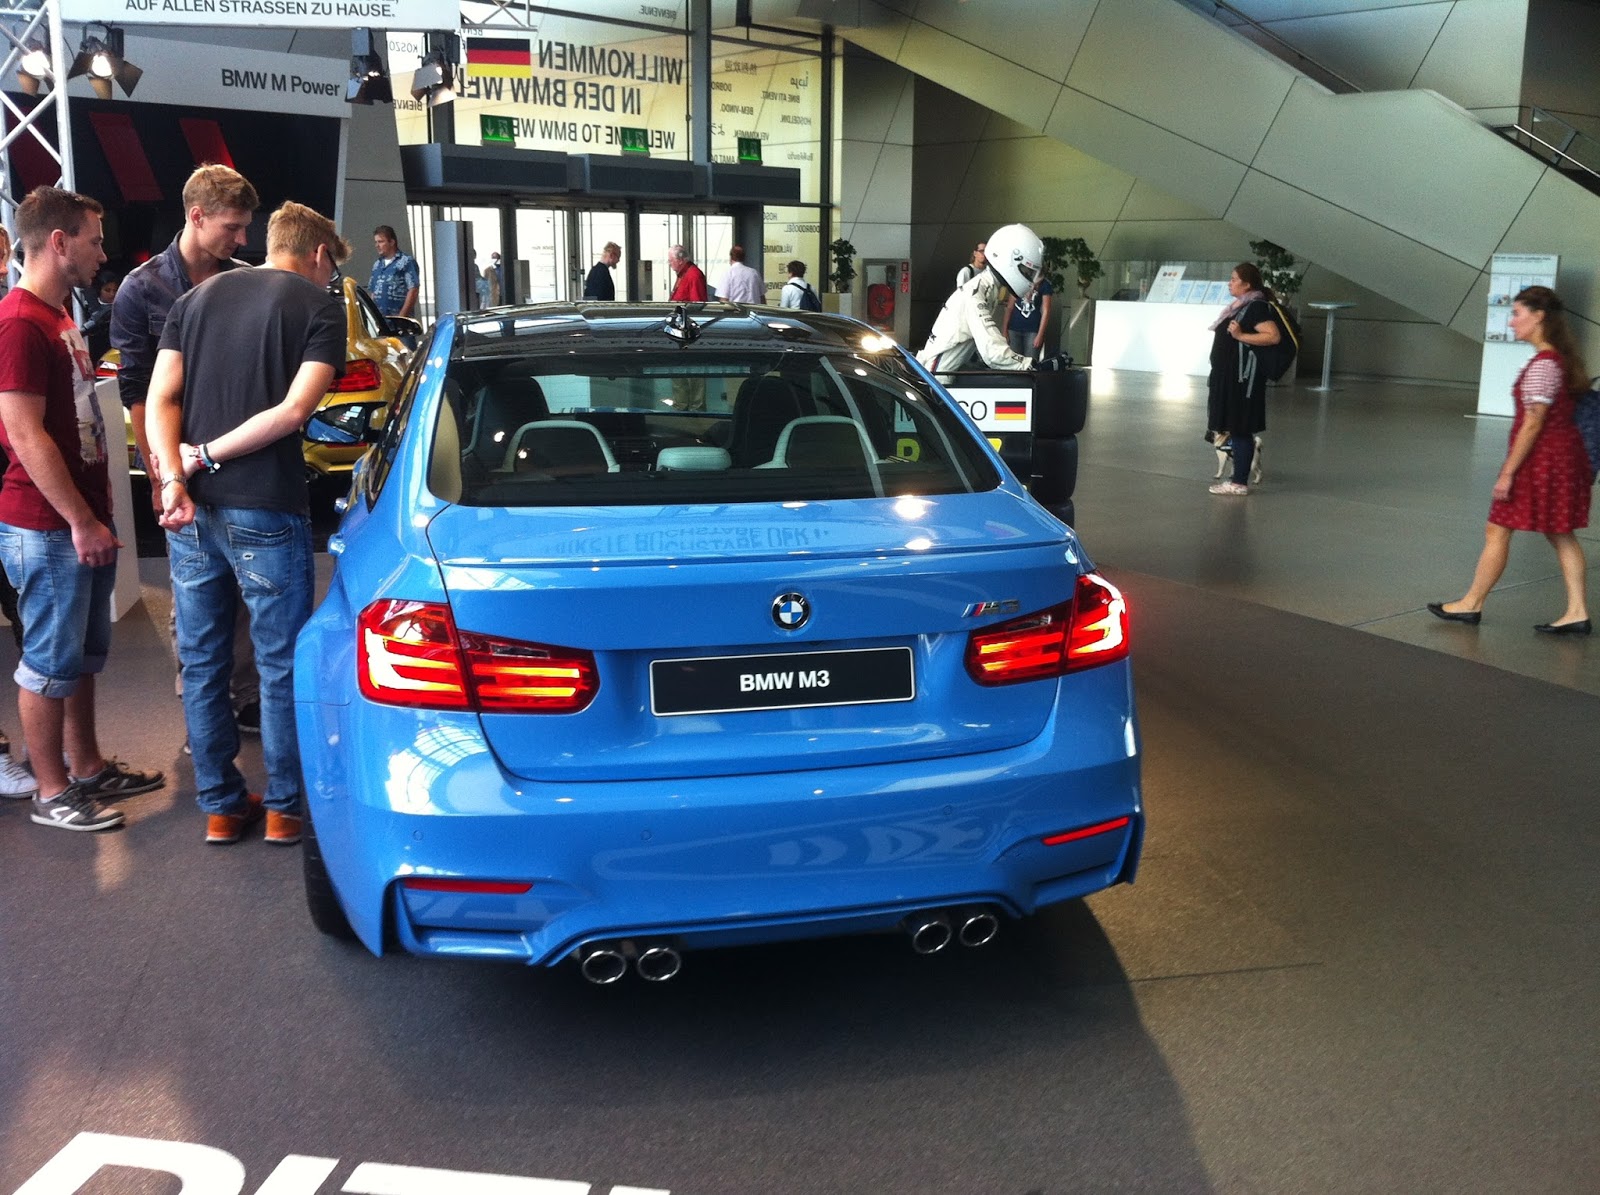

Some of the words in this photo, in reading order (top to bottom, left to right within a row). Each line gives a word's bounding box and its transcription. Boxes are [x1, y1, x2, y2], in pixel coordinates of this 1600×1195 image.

[125, 0, 158, 11] AUF
[162, 0, 215, 12] ALLEN
[219, 0, 307, 15] STRASSEN
[311, 2, 332, 15] ZU
[336, 3, 396, 17] HAUSE.
[222, 68, 267, 89] BMW
[271, 73, 287, 91] M
[291, 75, 340, 96] Power
[740, 672, 794, 692] BMW
[798, 669, 830, 689] M3
